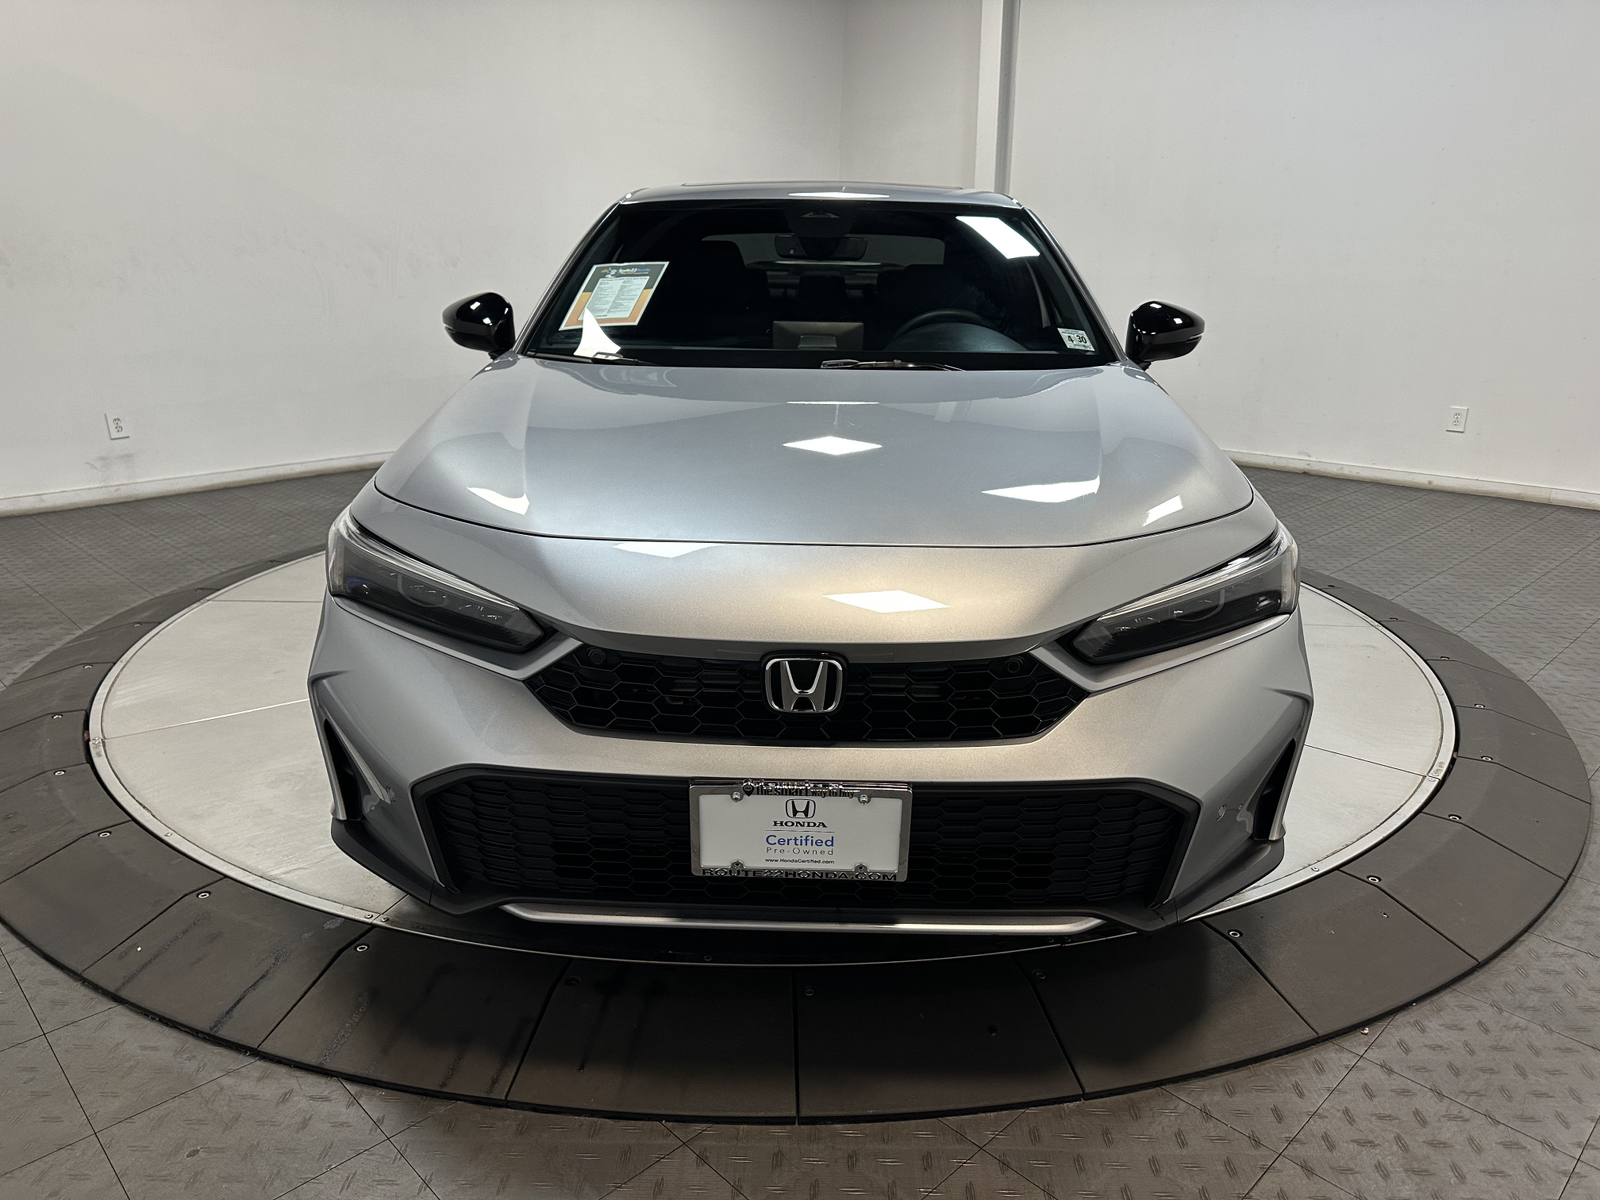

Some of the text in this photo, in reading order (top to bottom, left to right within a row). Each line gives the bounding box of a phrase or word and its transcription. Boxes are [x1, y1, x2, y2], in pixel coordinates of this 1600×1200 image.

[1067, 334, 1088, 344] 4 30
[774, 784, 811, 797] smart
[810, 789, 829, 798] way
[772, 820, 828, 828] HONDA
[765, 834, 834, 847] Certified
[766, 846, 834, 856] Pre-Owned
[702, 867, 897, 881] ROUTE22HONDA.COM
